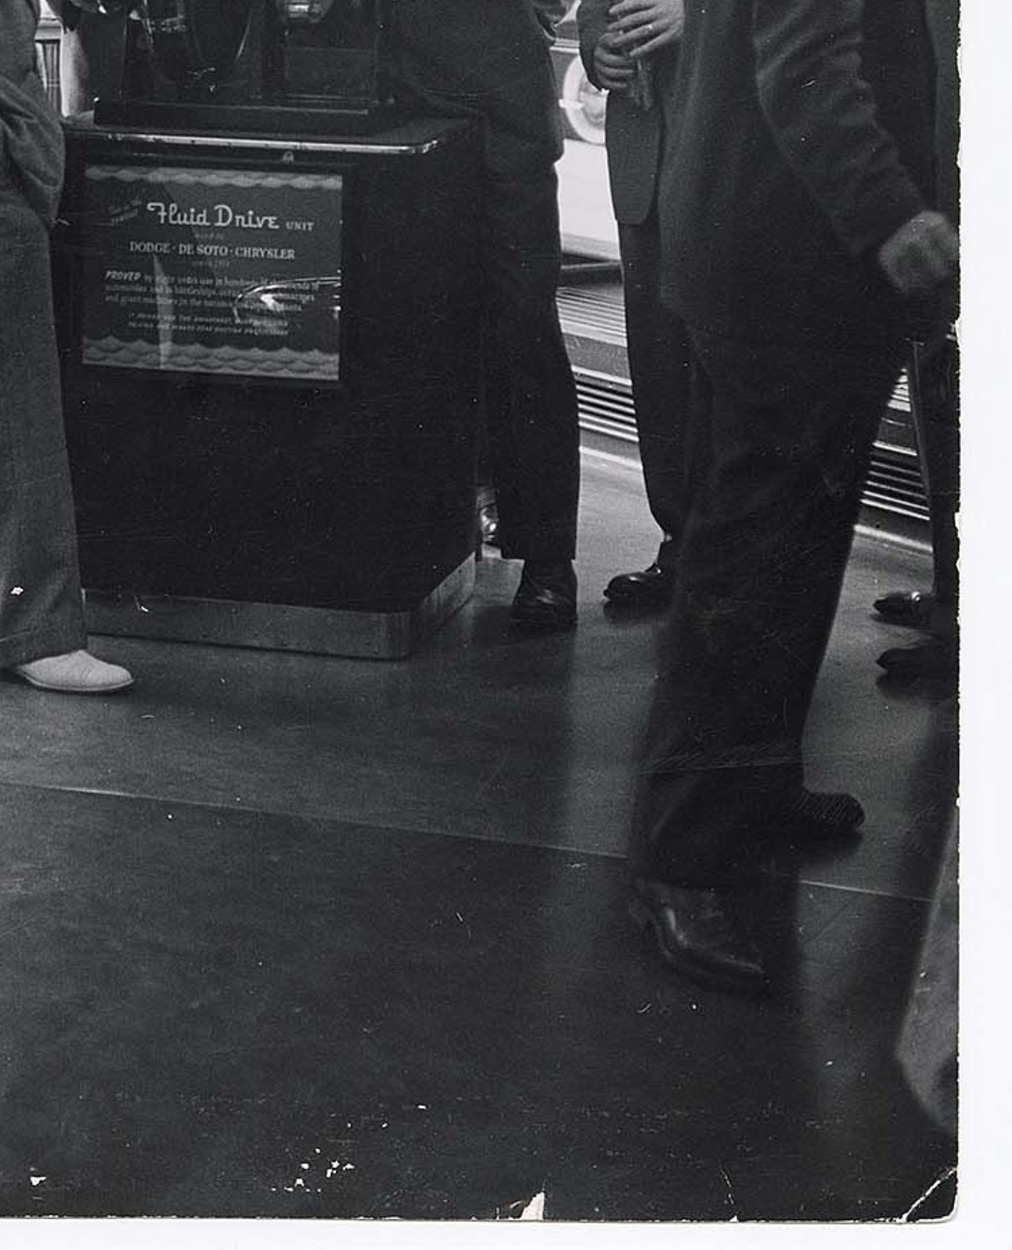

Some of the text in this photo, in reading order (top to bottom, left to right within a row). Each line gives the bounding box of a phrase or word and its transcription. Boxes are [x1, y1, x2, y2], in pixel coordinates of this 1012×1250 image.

[147, 202, 211, 227] Fluid
[213, 204, 280, 230] Drive
[286, 221, 315, 232] UNIT
[129, 241, 296, 260] DODGE DE SOTO CHRYSLER
[105, 270, 141, 281] PROVED
